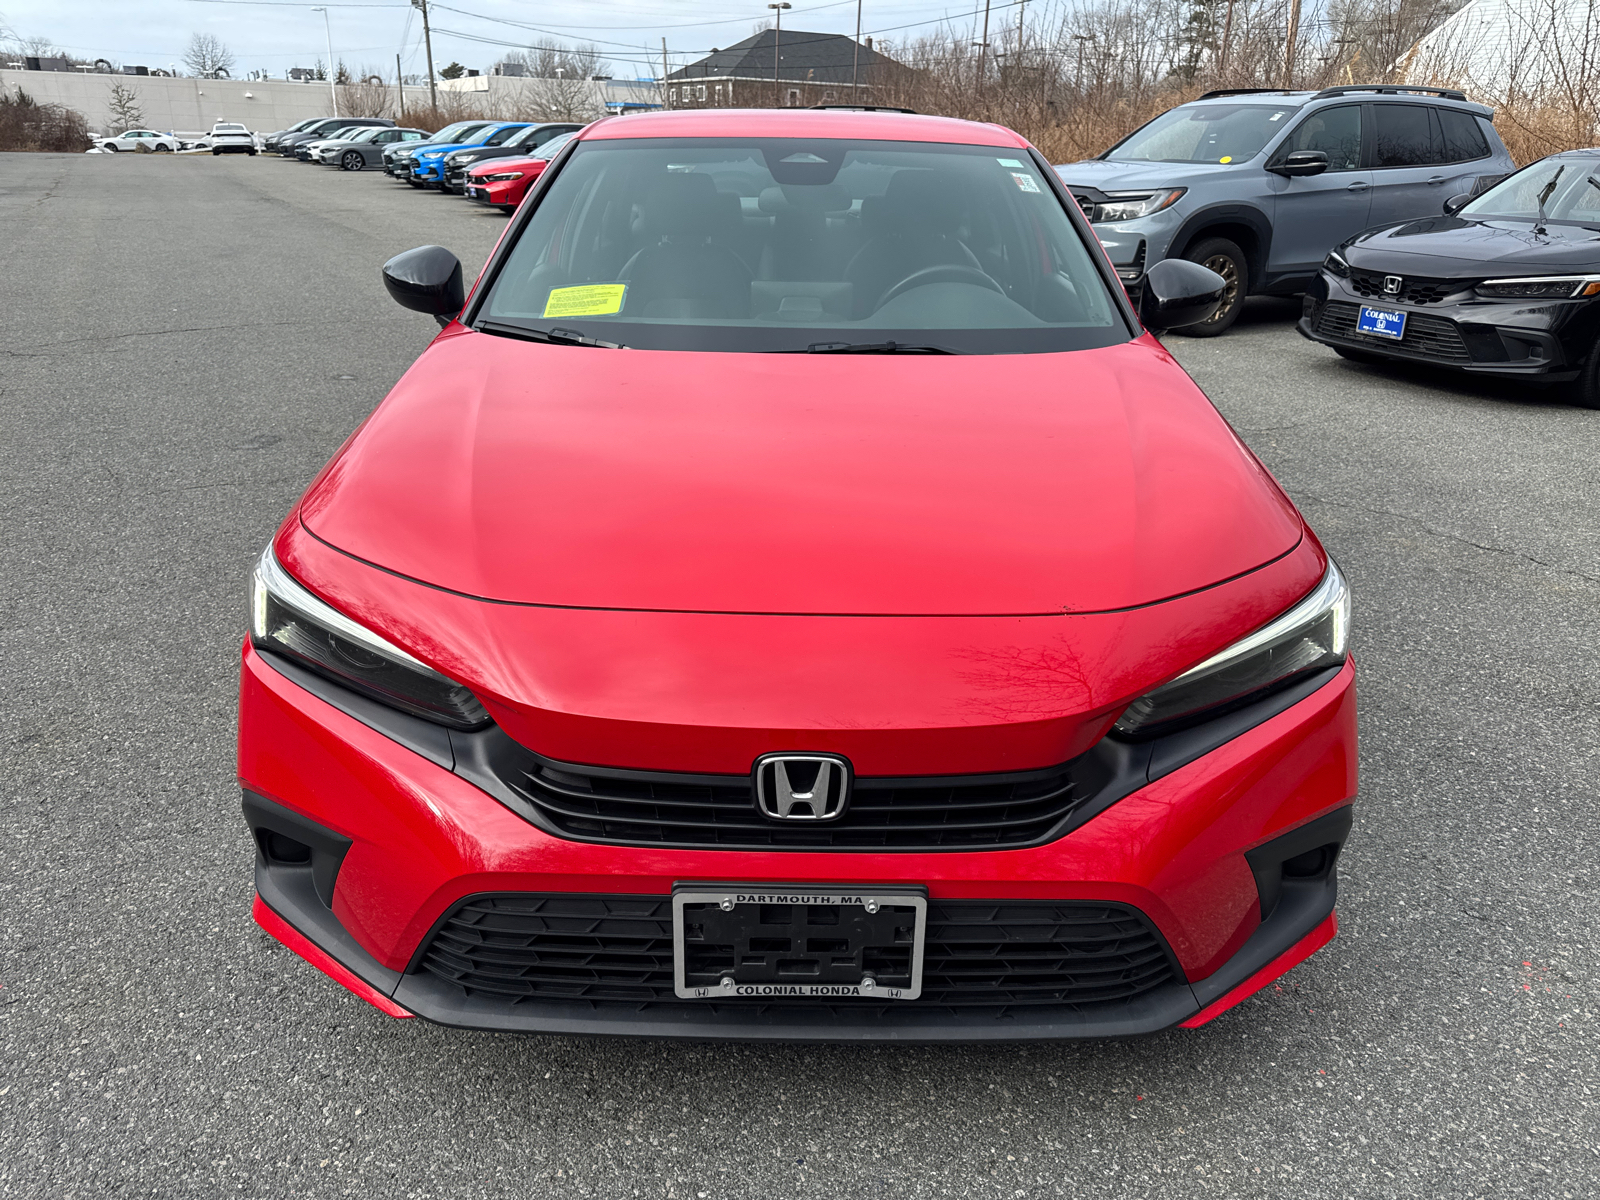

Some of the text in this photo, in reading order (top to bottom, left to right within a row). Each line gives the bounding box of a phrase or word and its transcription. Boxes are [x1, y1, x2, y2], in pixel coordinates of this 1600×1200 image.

[1365, 307, 1401, 323] COLONIAL
[736, 894, 863, 904] DARTMOUTH, MA
[736, 986, 806, 995] COLONIAL
[809, 986, 860, 995] HONDA
